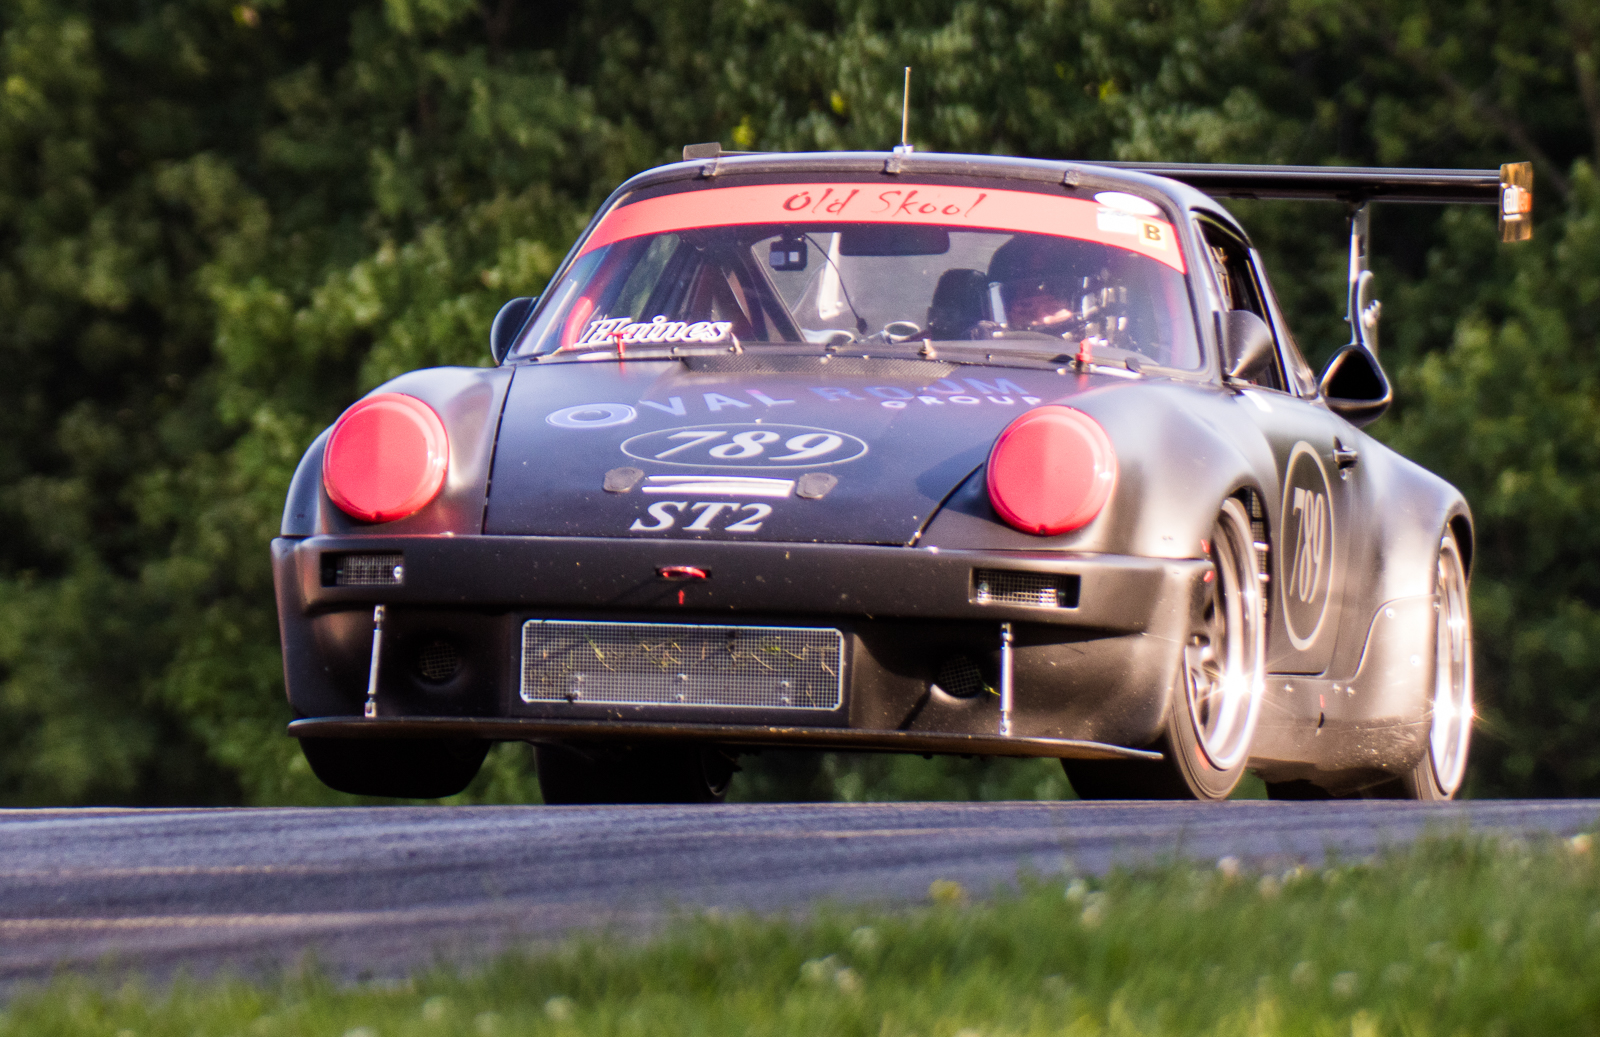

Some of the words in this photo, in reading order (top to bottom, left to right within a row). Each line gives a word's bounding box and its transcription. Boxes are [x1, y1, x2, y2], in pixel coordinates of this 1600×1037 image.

[782, 188, 860, 216] Old
[870, 190, 988, 218] Skool
[1143, 223, 1162, 242] B
[880, 394, 1041, 409] GROUP
[654, 431, 844, 460] 789
[629, 501, 773, 532] ST2
[1290, 487, 1325, 604] 789
